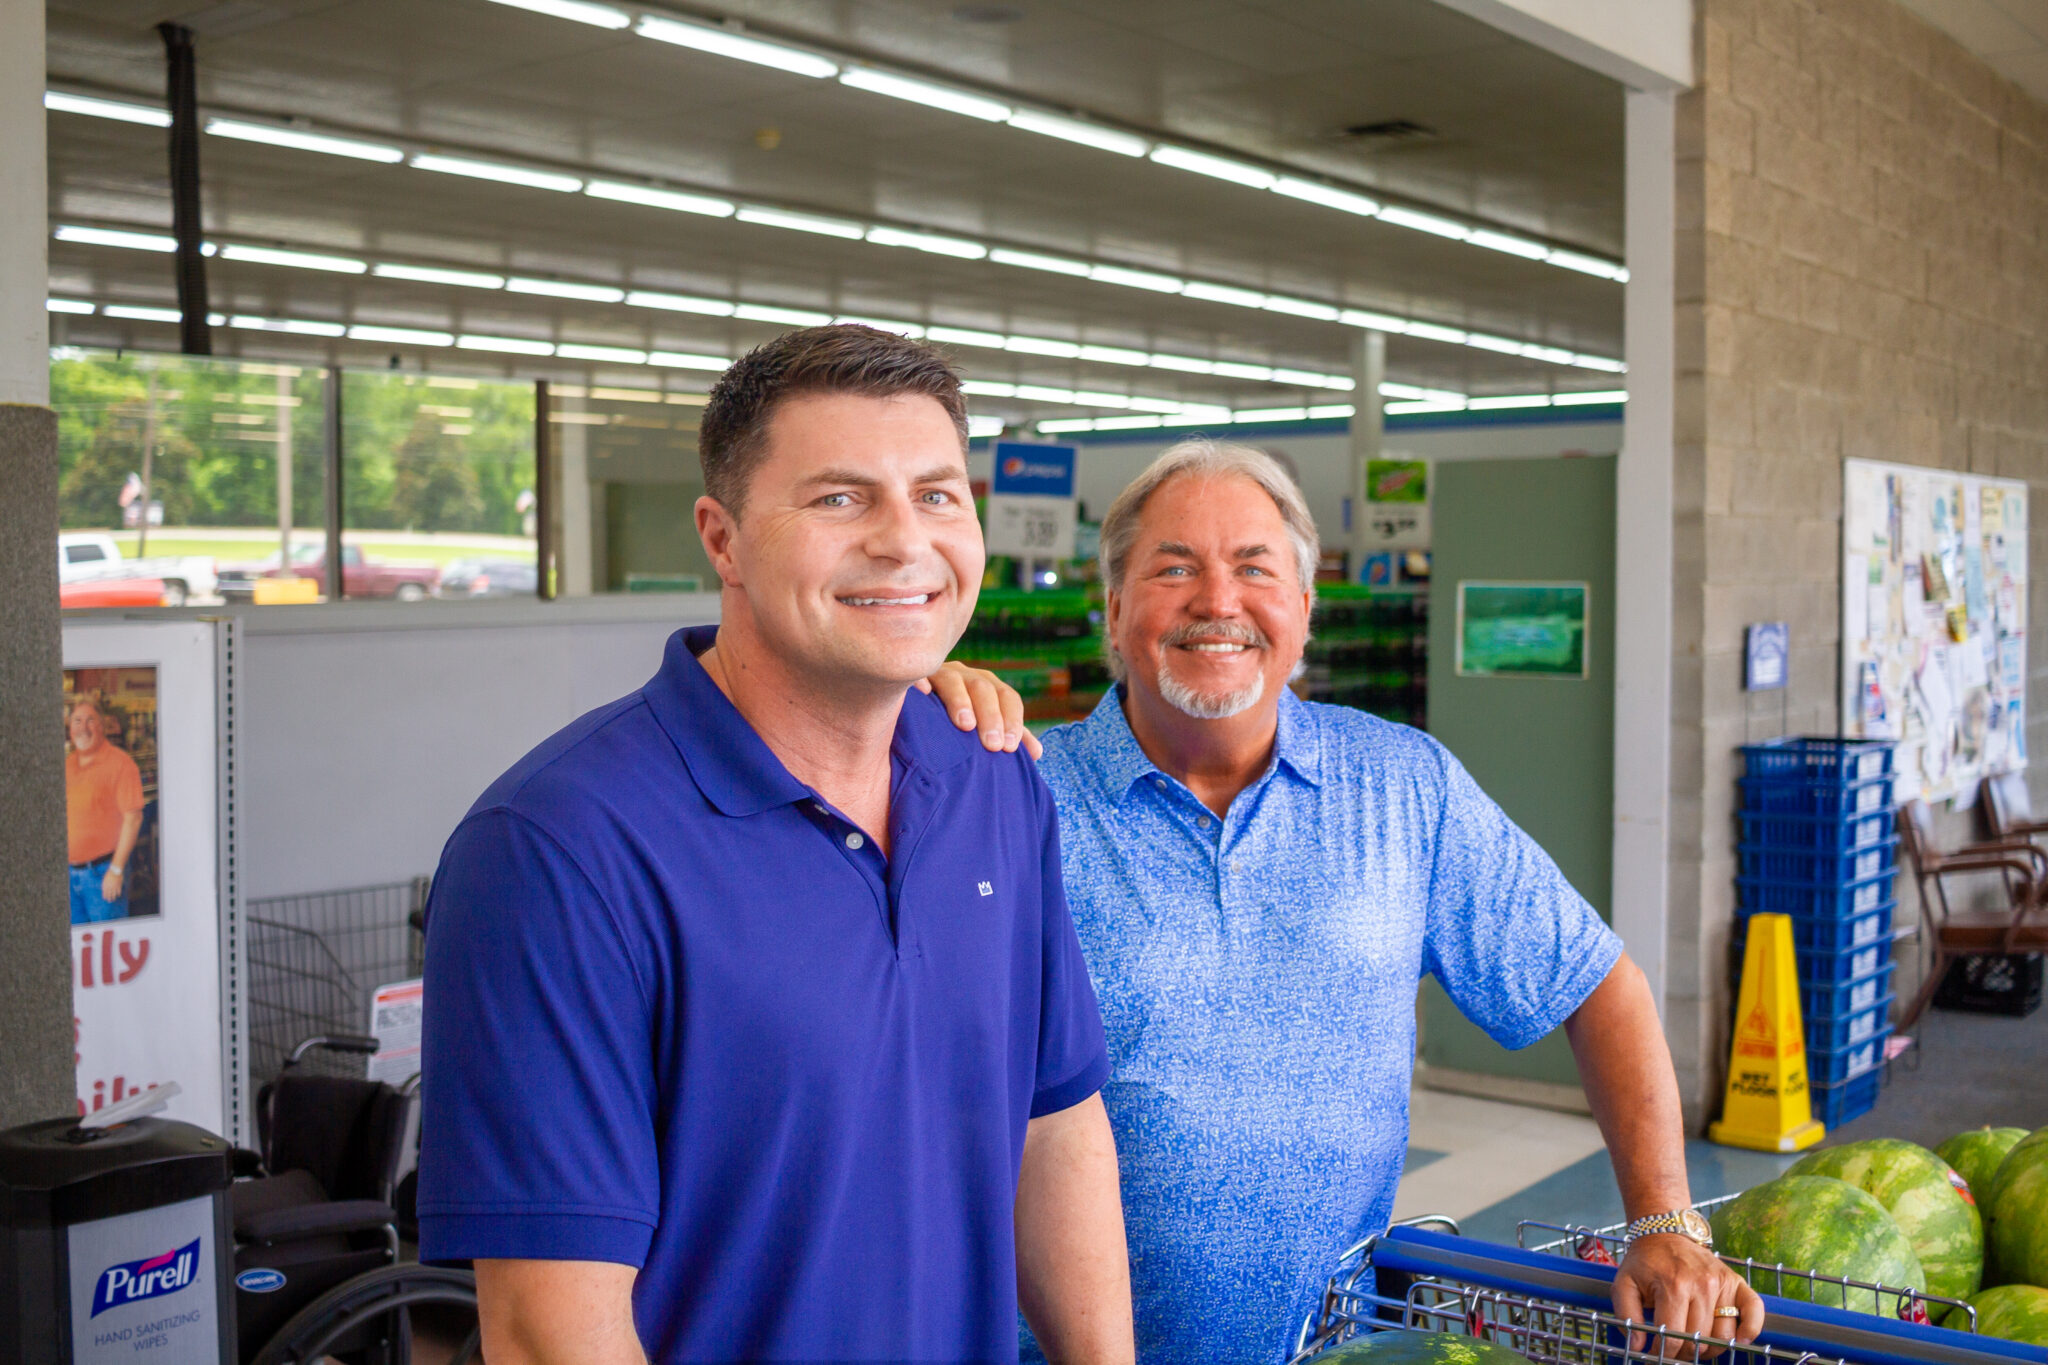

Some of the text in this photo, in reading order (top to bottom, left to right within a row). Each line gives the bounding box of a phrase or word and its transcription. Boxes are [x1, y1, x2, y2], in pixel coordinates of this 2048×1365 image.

[73, 930, 150, 988] ily
[105, 1251, 193, 1304] Purell
[94, 1308, 201, 1347] HAND SANITIZING
[132, 1333, 169, 1352] WIPES
